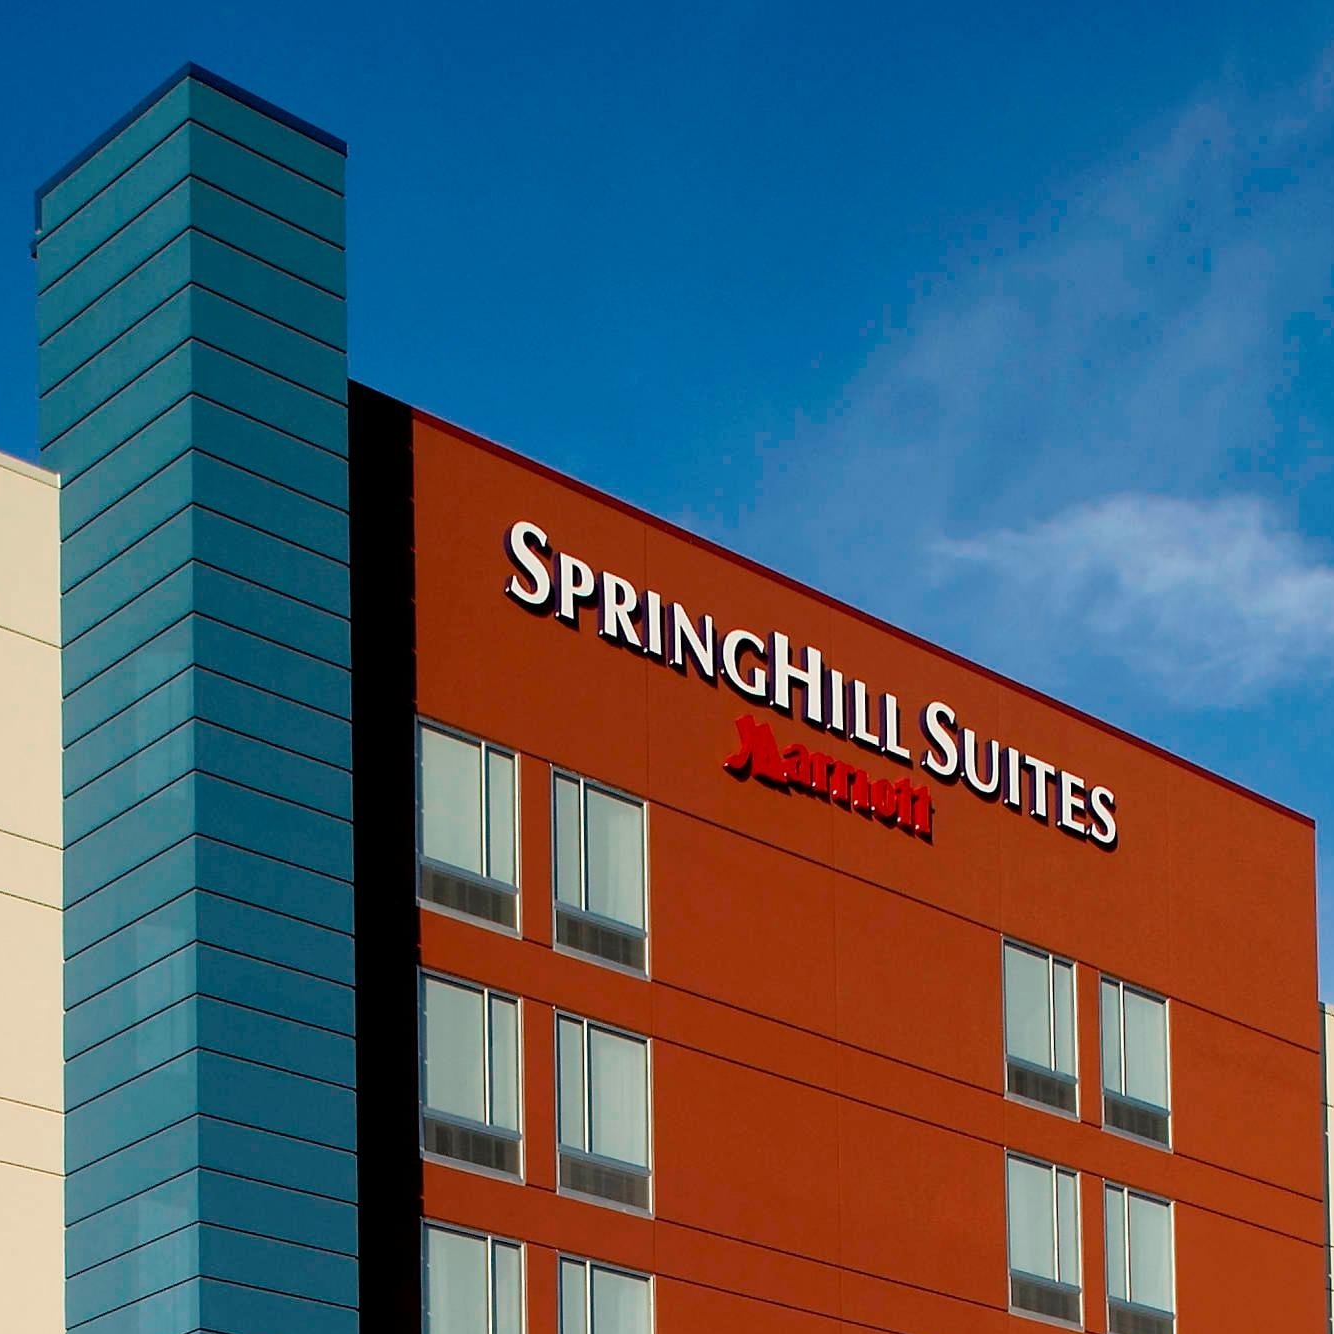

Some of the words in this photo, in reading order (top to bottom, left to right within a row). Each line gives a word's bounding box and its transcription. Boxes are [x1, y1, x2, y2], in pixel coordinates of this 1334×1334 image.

[505, 520, 911, 762] SPRINGHILL
[921, 700, 1119, 847] SUITES
[723, 714, 934, 841] Marriott
